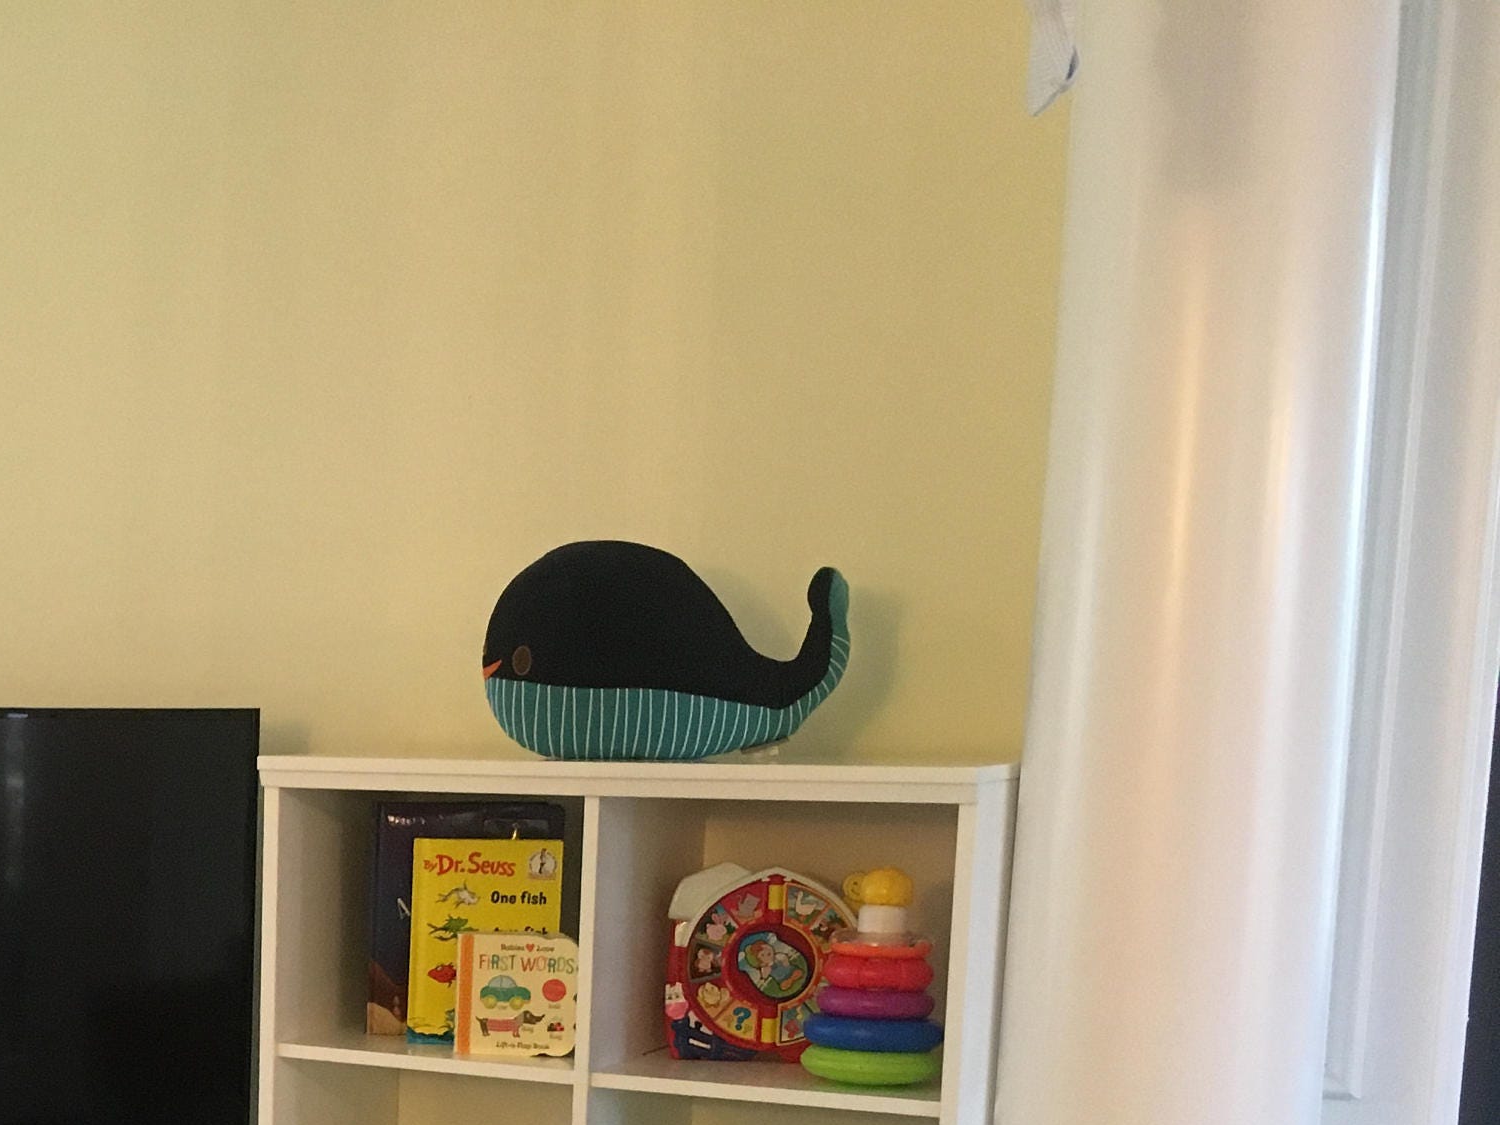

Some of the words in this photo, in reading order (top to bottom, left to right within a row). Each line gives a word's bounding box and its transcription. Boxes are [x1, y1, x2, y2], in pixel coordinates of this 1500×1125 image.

[423, 859, 437, 872] By
[436, 854, 466, 877] Dr.
[467, 852, 516, 877] Seuss
[490, 892, 517, 905] One
[520, 891, 547, 905] fish
[478, 953, 516, 971] FIRST
[520, 955, 575, 974] WORDS
